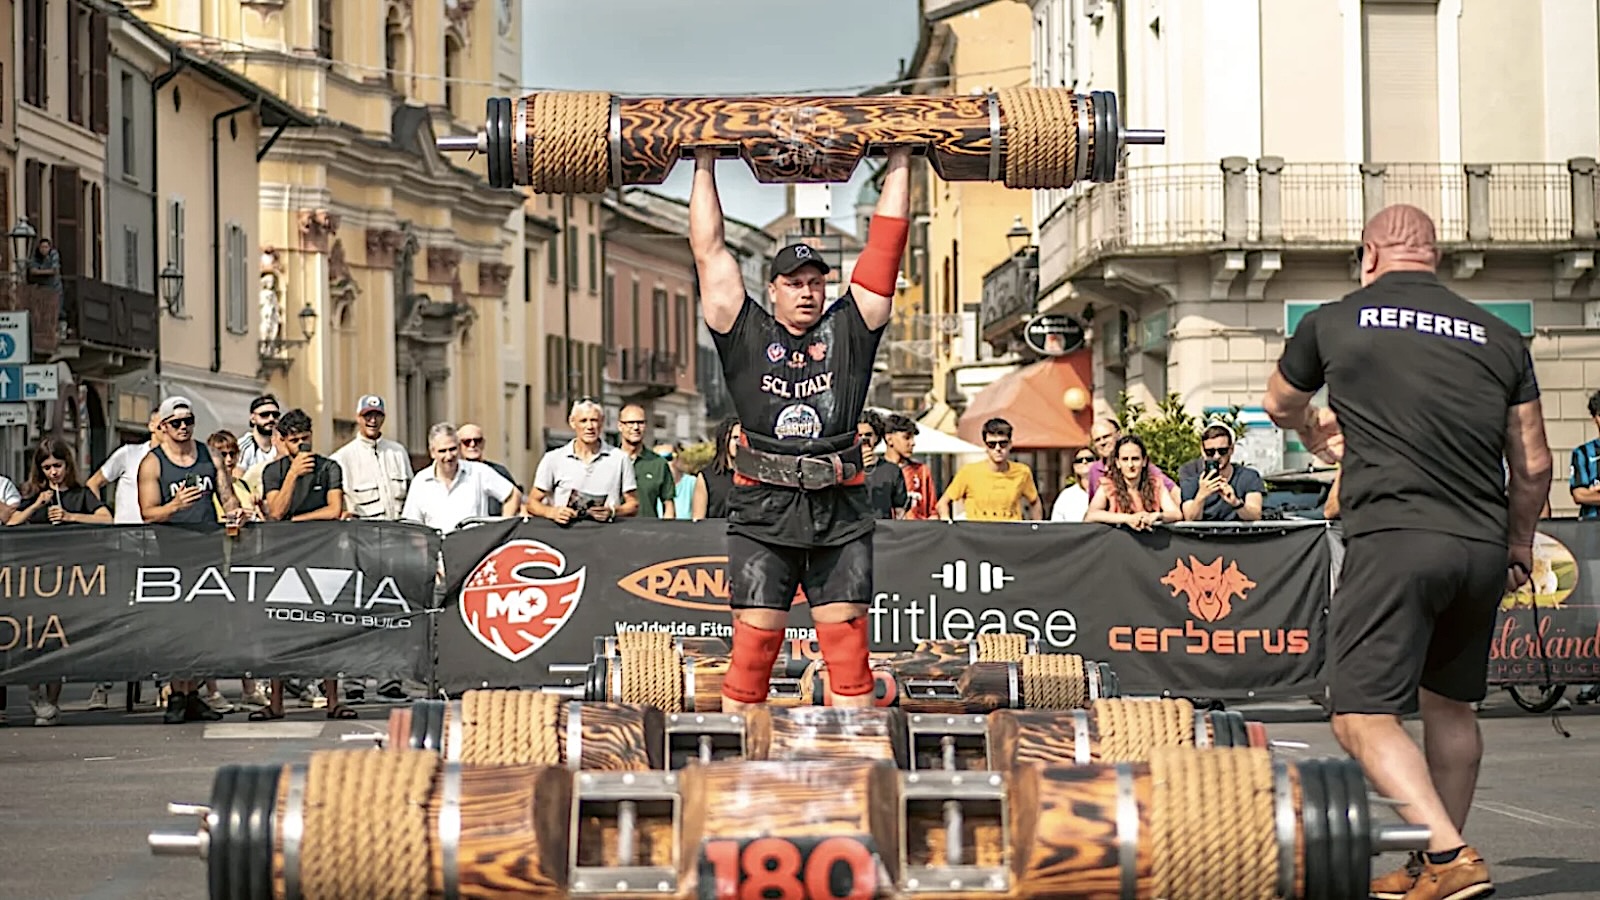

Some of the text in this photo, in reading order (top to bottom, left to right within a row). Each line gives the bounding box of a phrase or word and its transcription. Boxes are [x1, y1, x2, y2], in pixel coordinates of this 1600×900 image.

[1359, 308, 1488, 344] REFEREE
[761, 371, 833, 398] SCL ITALY
[136, 566, 411, 613] BATAVIA
[652, 568, 730, 598] PAN
[265, 608, 412, 629] TOOLS TO BUILD
[615, 621, 695, 636] Worldwide
[700, 621, 735, 637] Fitn
[868, 593, 1078, 648] fitlease
[705, 837, 876, 900] 180
